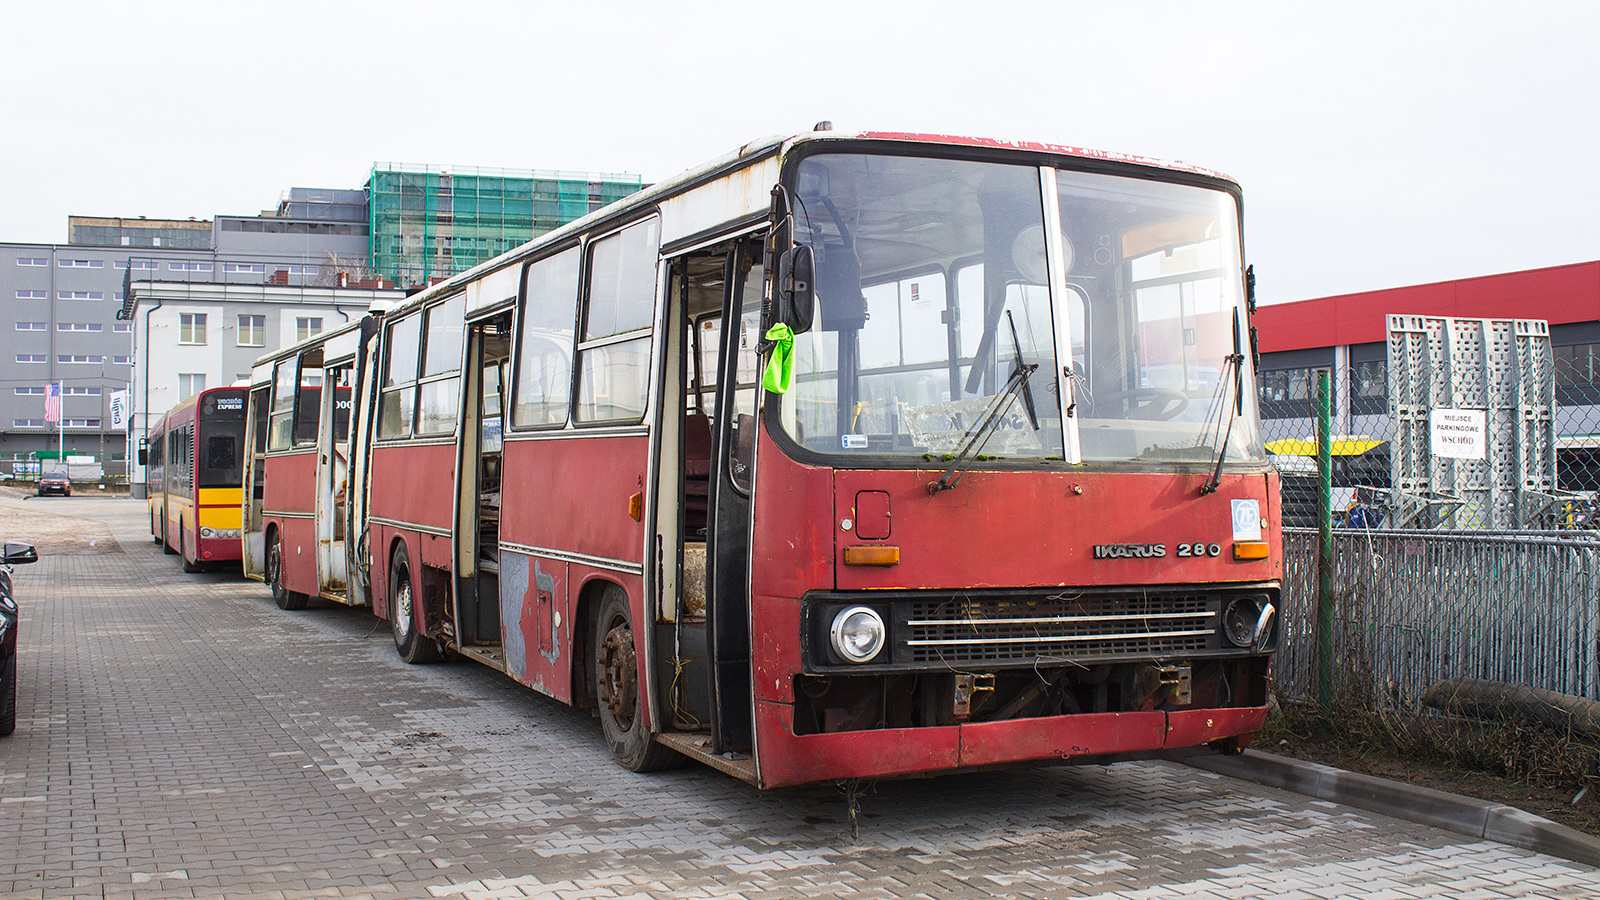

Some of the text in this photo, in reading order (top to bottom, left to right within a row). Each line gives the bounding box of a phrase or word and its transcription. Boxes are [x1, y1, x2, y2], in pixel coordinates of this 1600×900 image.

[1436, 424, 1479, 433] PARKINGOWE
[1094, 543, 1221, 559] IKARUS 280
